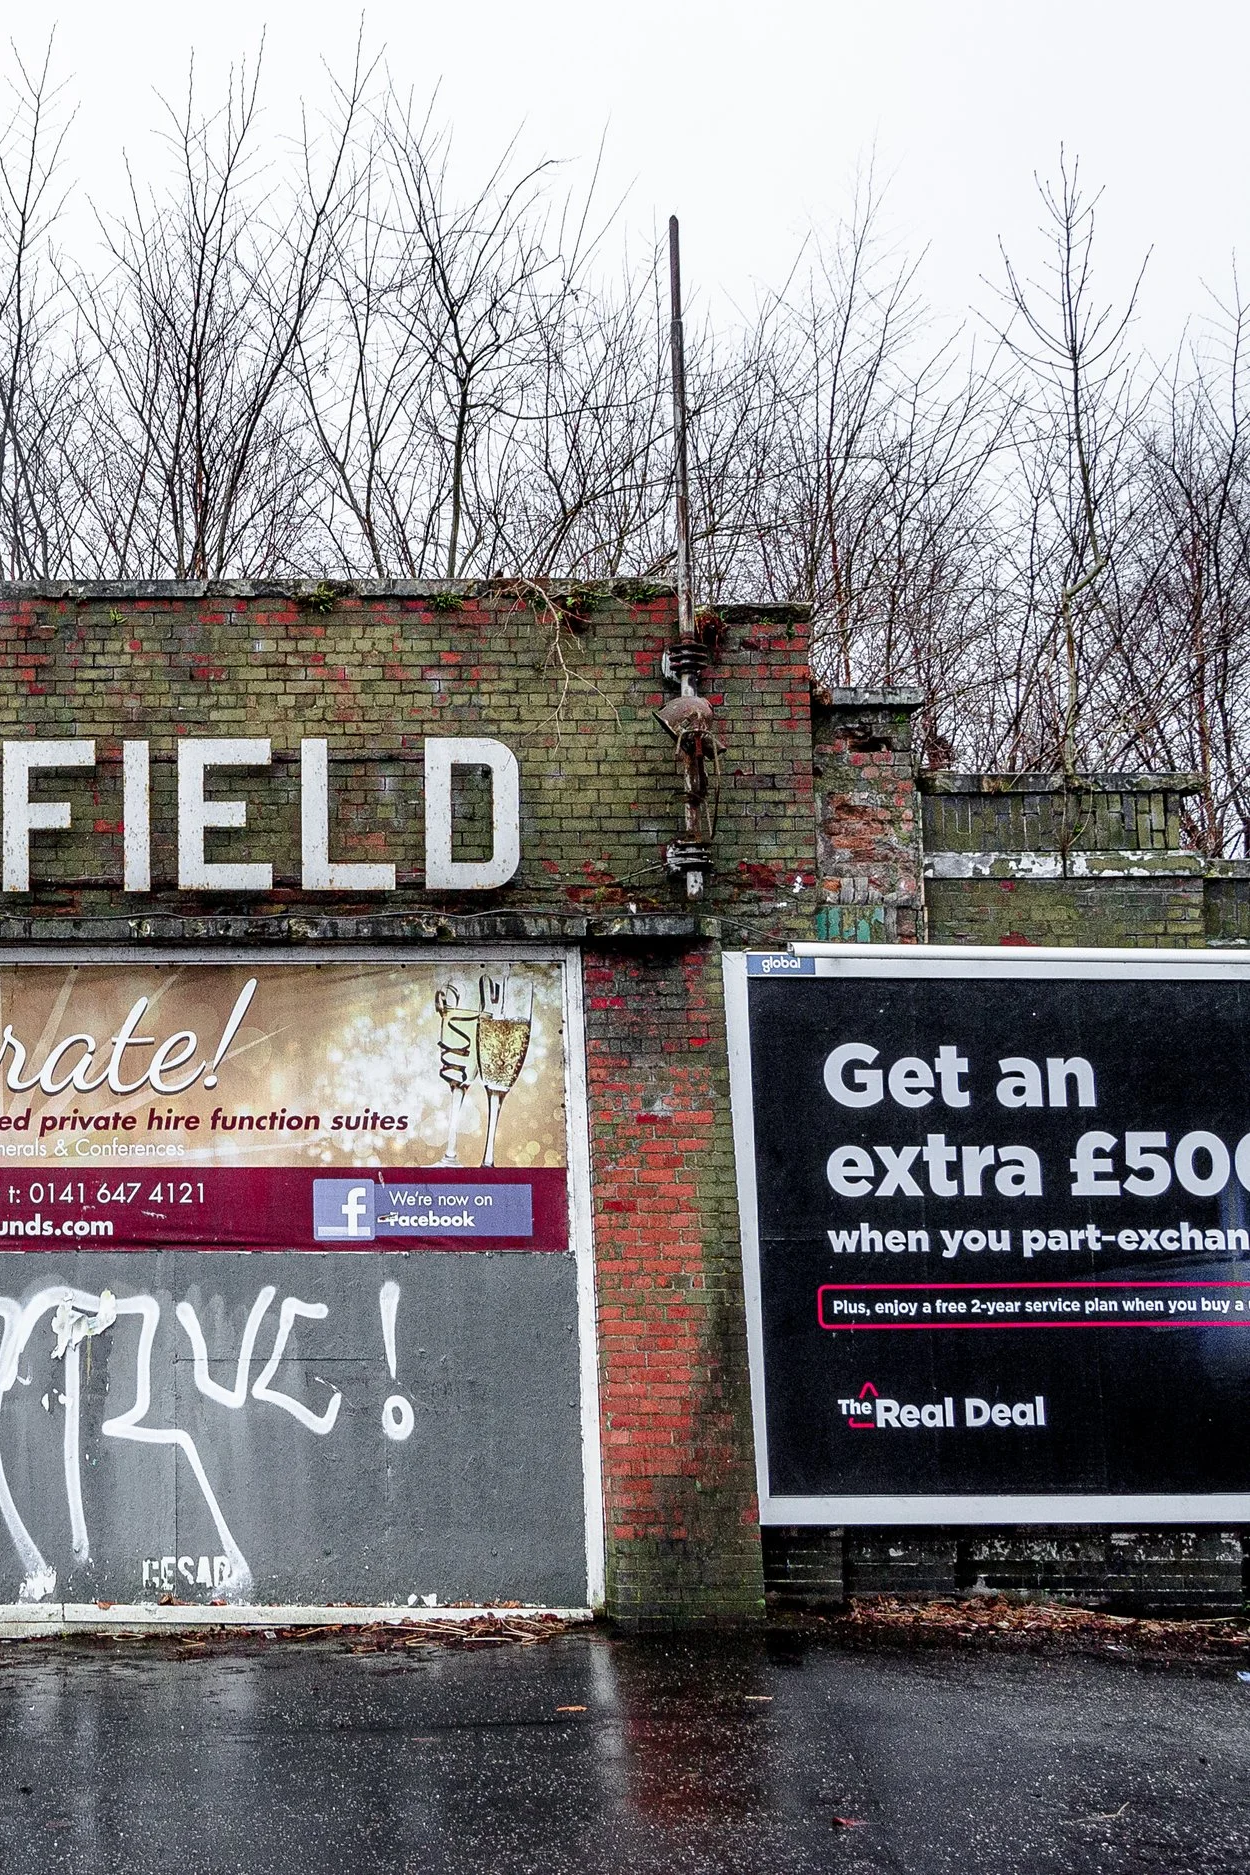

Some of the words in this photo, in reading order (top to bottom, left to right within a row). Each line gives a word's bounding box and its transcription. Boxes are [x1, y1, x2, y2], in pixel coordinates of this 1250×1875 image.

[762, 956, 801, 973] global
[823, 1042, 971, 1108] Get
[996, 1056, 1097, 1107] an
[39, 1108, 137, 1137] private
[147, 1107, 200, 1131] hire
[210, 1107, 321, 1131] function
[330, 1108, 409, 1131] suites
[54, 1139, 69, 1157] &
[75, 1138, 184, 1157] Conferences
[827, 1133, 1043, 1197] extra
[1070, 1130, 1250, 1197] £50
[8, 1186, 21, 1204] t:
[29, 1182, 84, 1204] 0141
[97, 1182, 141, 1204] 647
[149, 1182, 204, 1204] 4121
[389, 1190, 432, 1206] We're
[438, 1194, 468, 1206] now
[474, 1194, 493, 1206] on
[341, 1187, 366, 1236] f
[827, 1222, 931, 1253] when
[940, 1229, 1012, 1258] you
[833, 1300, 871, 1316] Plus,
[875, 1300, 918, 1316] enjoy
[922, 1303, 932, 1313] a
[935, 1299, 967, 1313] free
[971, 1299, 1021, 1315] 2-year
[1025, 1298, 1080, 1312] service
[1085, 1297, 1118, 1314] plan
[1122, 1297, 1164, 1311] when
[1168, 1299, 1197, 1314] you
[1201, 1297, 1230, 1314] buy
[1235, 1300, 1244, 1311] a
[838, 1399, 872, 1415] The
[876, 1397, 955, 1428] Real
[965, 1396, 1047, 1427] Deal
